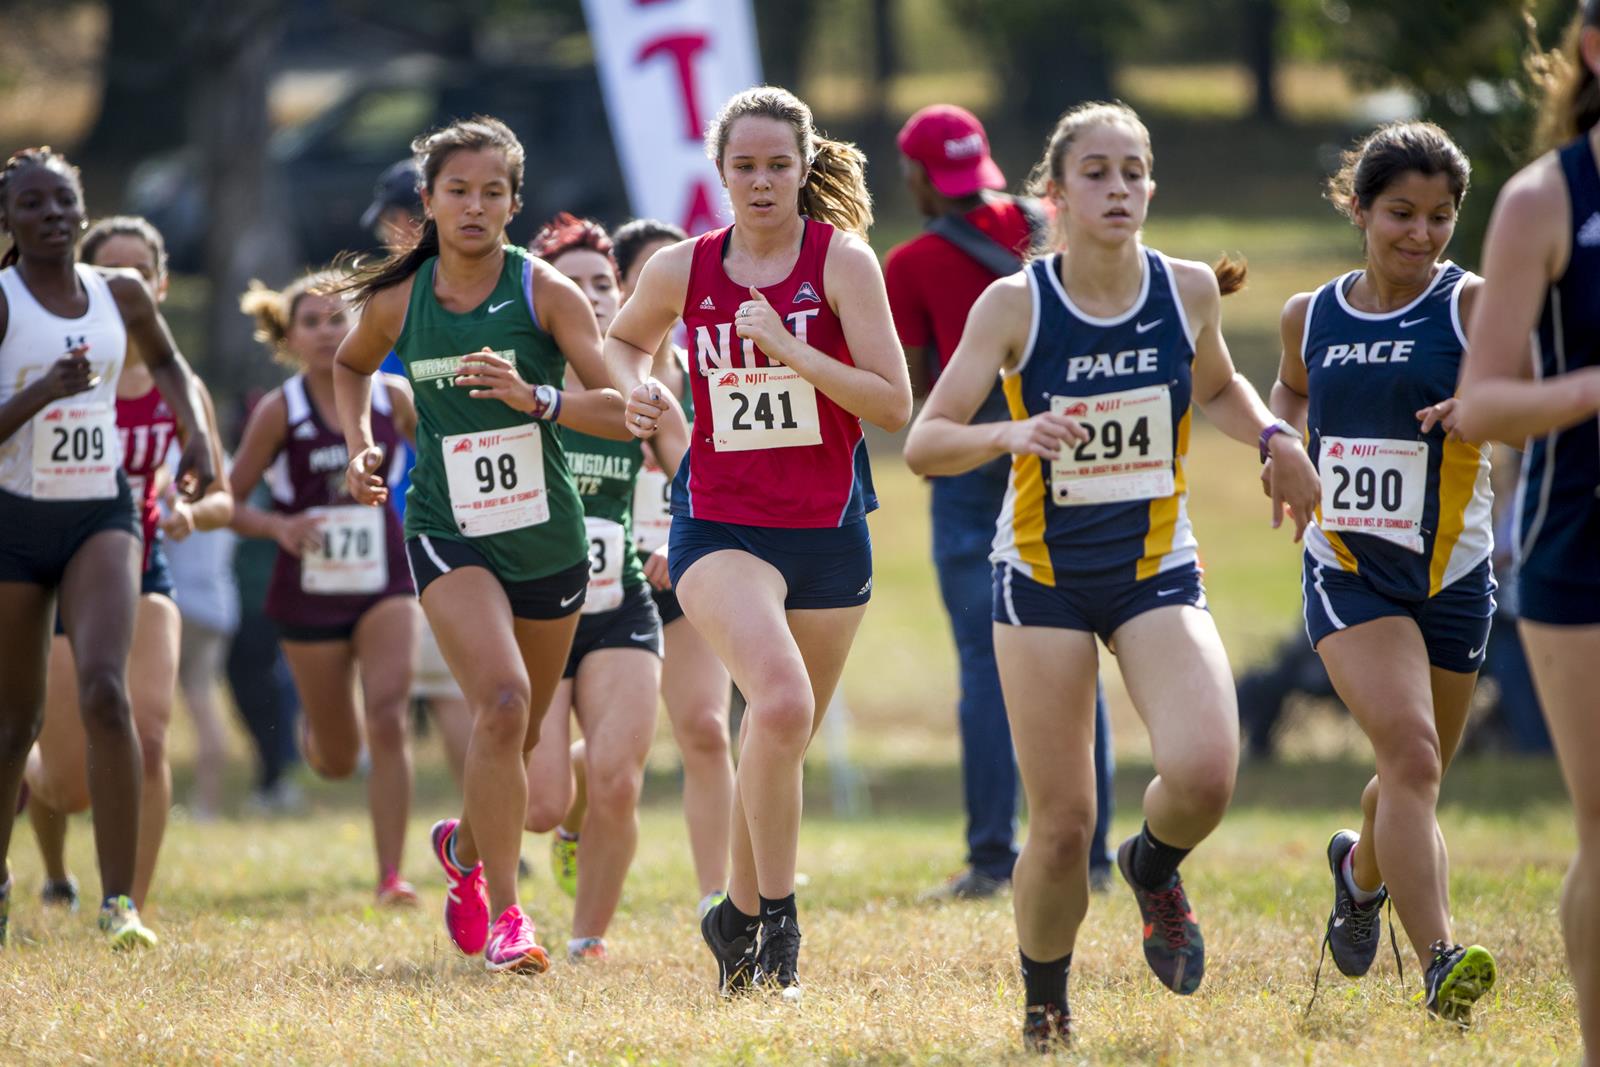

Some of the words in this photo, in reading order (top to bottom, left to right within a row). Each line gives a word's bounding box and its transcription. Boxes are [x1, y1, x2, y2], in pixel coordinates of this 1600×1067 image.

[695, 308, 820, 377] NT
[1321, 340, 1416, 368] PACE
[745, 373, 768, 385] NJIT
[1066, 348, 1159, 382] PACE
[729, 391, 798, 431] 241
[52, 427, 104, 462] 209
[479, 435, 501, 448] NJIT
[1074, 416, 1151, 462] 294
[1351, 444, 1379, 457] NJIT
[475, 453, 518, 493] 98
[564, 451, 632, 481] INGDALE
[1332, 465, 1404, 512] 290
[591, 537, 606, 573] 3
